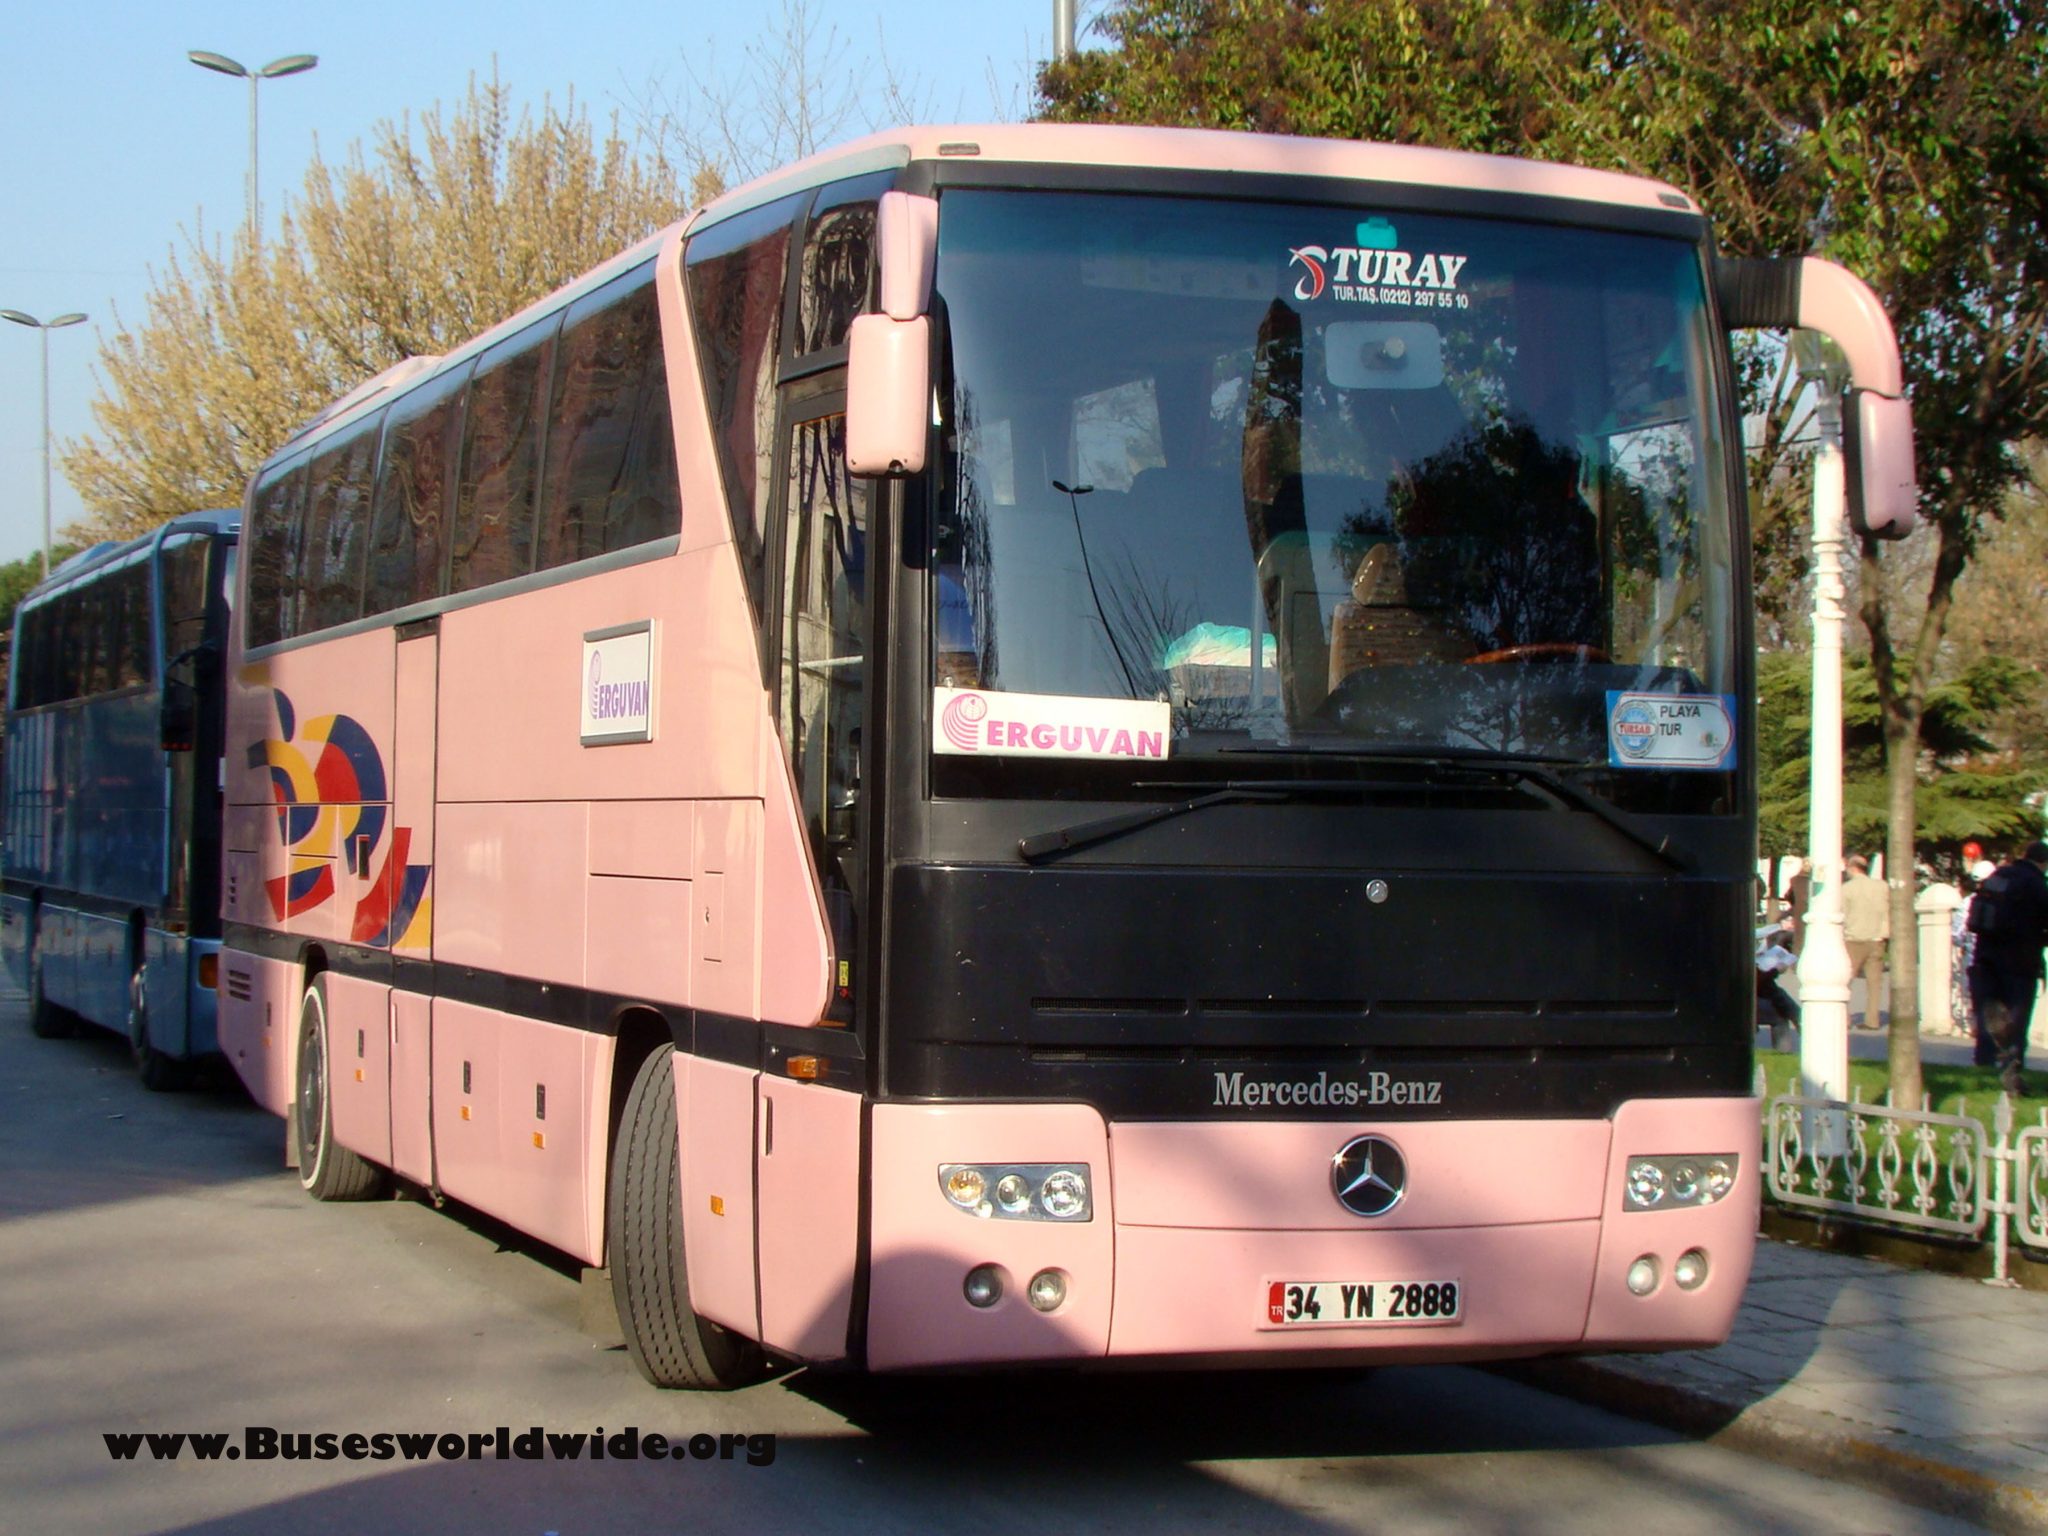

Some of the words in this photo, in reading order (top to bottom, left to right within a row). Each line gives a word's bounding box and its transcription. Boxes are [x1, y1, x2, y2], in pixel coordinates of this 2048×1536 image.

[1331, 248, 1467, 289] TURAY
[1380, 288, 1411, 306] (0212)
[1414, 291, 1435, 306] 297
[1438, 292, 1453, 308] 55
[1455, 294, 1469, 309] 10
[598, 681, 649, 719] ERGUVAN
[1660, 706, 1701, 718] PLAYA
[987, 720, 1161, 758] ERGUVAN
[1659, 723, 1682, 736] TUR
[1212, 1071, 1442, 1106] Mercedes-Benz
[1271, 1306, 1284, 1316] TR
[1286, 1286, 1320, 1319] 34
[1341, 1285, 1373, 1318] YN
[1389, 1283, 1457, 1317] 2888
